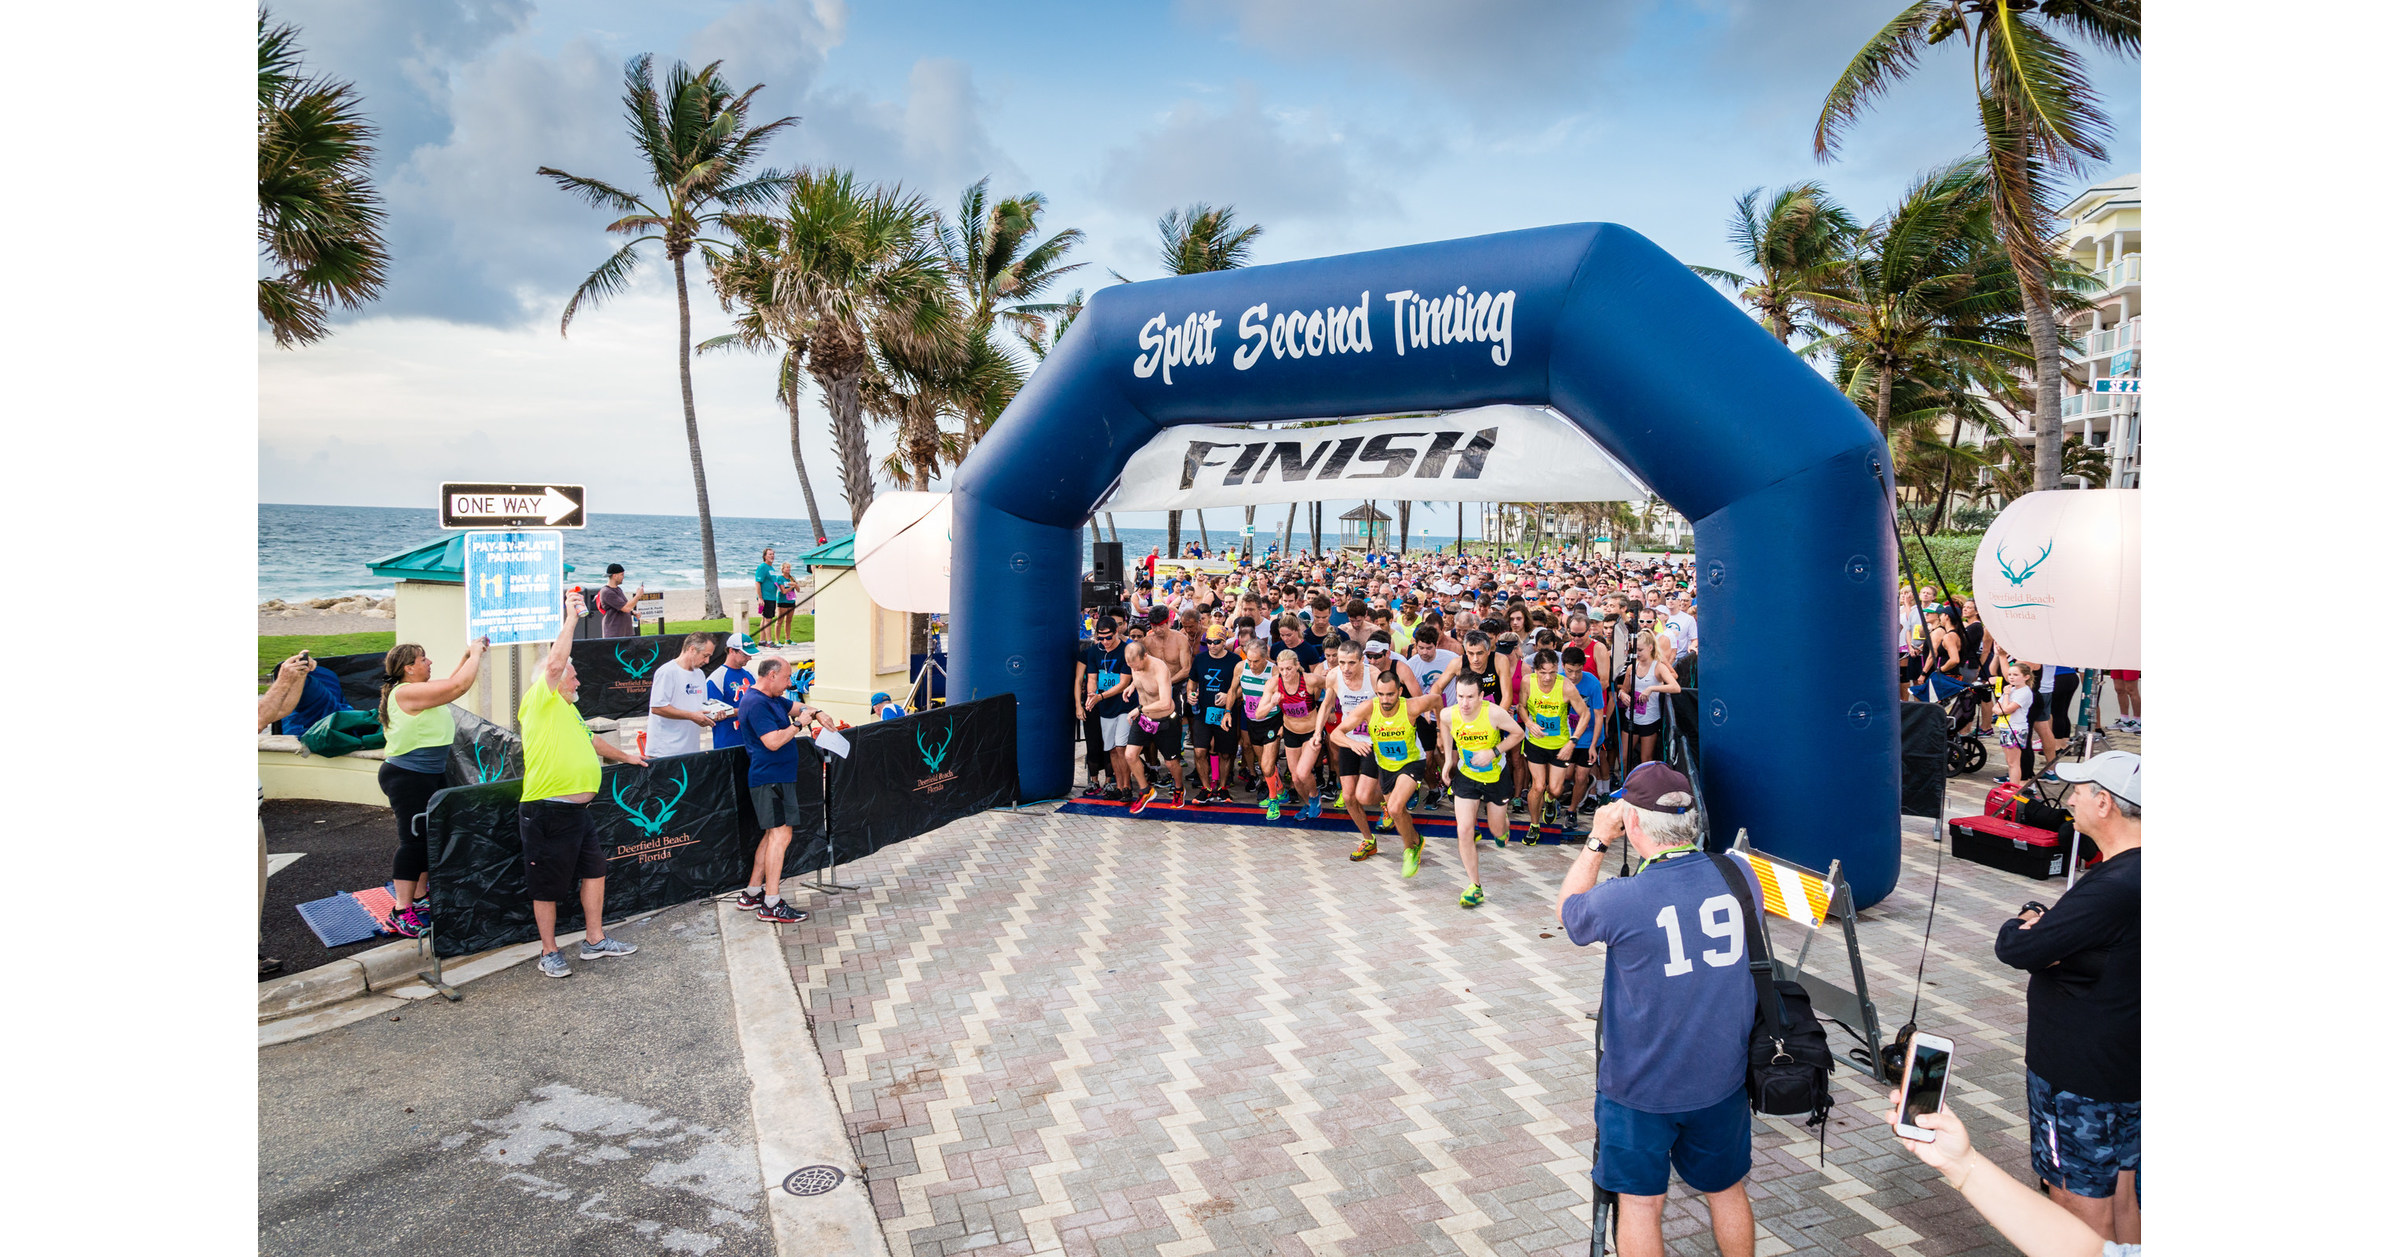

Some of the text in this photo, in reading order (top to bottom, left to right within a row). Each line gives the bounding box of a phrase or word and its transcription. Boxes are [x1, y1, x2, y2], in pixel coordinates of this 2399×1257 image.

[1133, 285, 1516, 385] Split Second Timing
[2109, 381, 2123, 392] SE
[2125, 381, 2134, 392] 2
[1178, 426, 1499, 490] FINISH
[457, 497, 542, 514] ONE WAY
[472, 541, 556, 552] PAY-BY-PLATE
[487, 552, 542, 562] PARKING
[510, 573, 550, 583] PAY AT
[1989, 591, 2055, 604] Deerfield Beach
[2005, 609, 2036, 620] Florida
[615, 680, 642, 688] Deerfield
[1103, 678, 1116, 687] 200
[1540, 720, 1555, 729] 316
[1385, 746, 1401, 754] 314
[917, 769, 954, 787] Deerfield Beach
[926, 784, 944, 794] Florida
[617, 832, 690, 855] Deerfield Beach
[638, 849, 672, 864] Florida
[1655, 893, 1744, 977] 19
[794, 1177, 833, 1186] WATER
